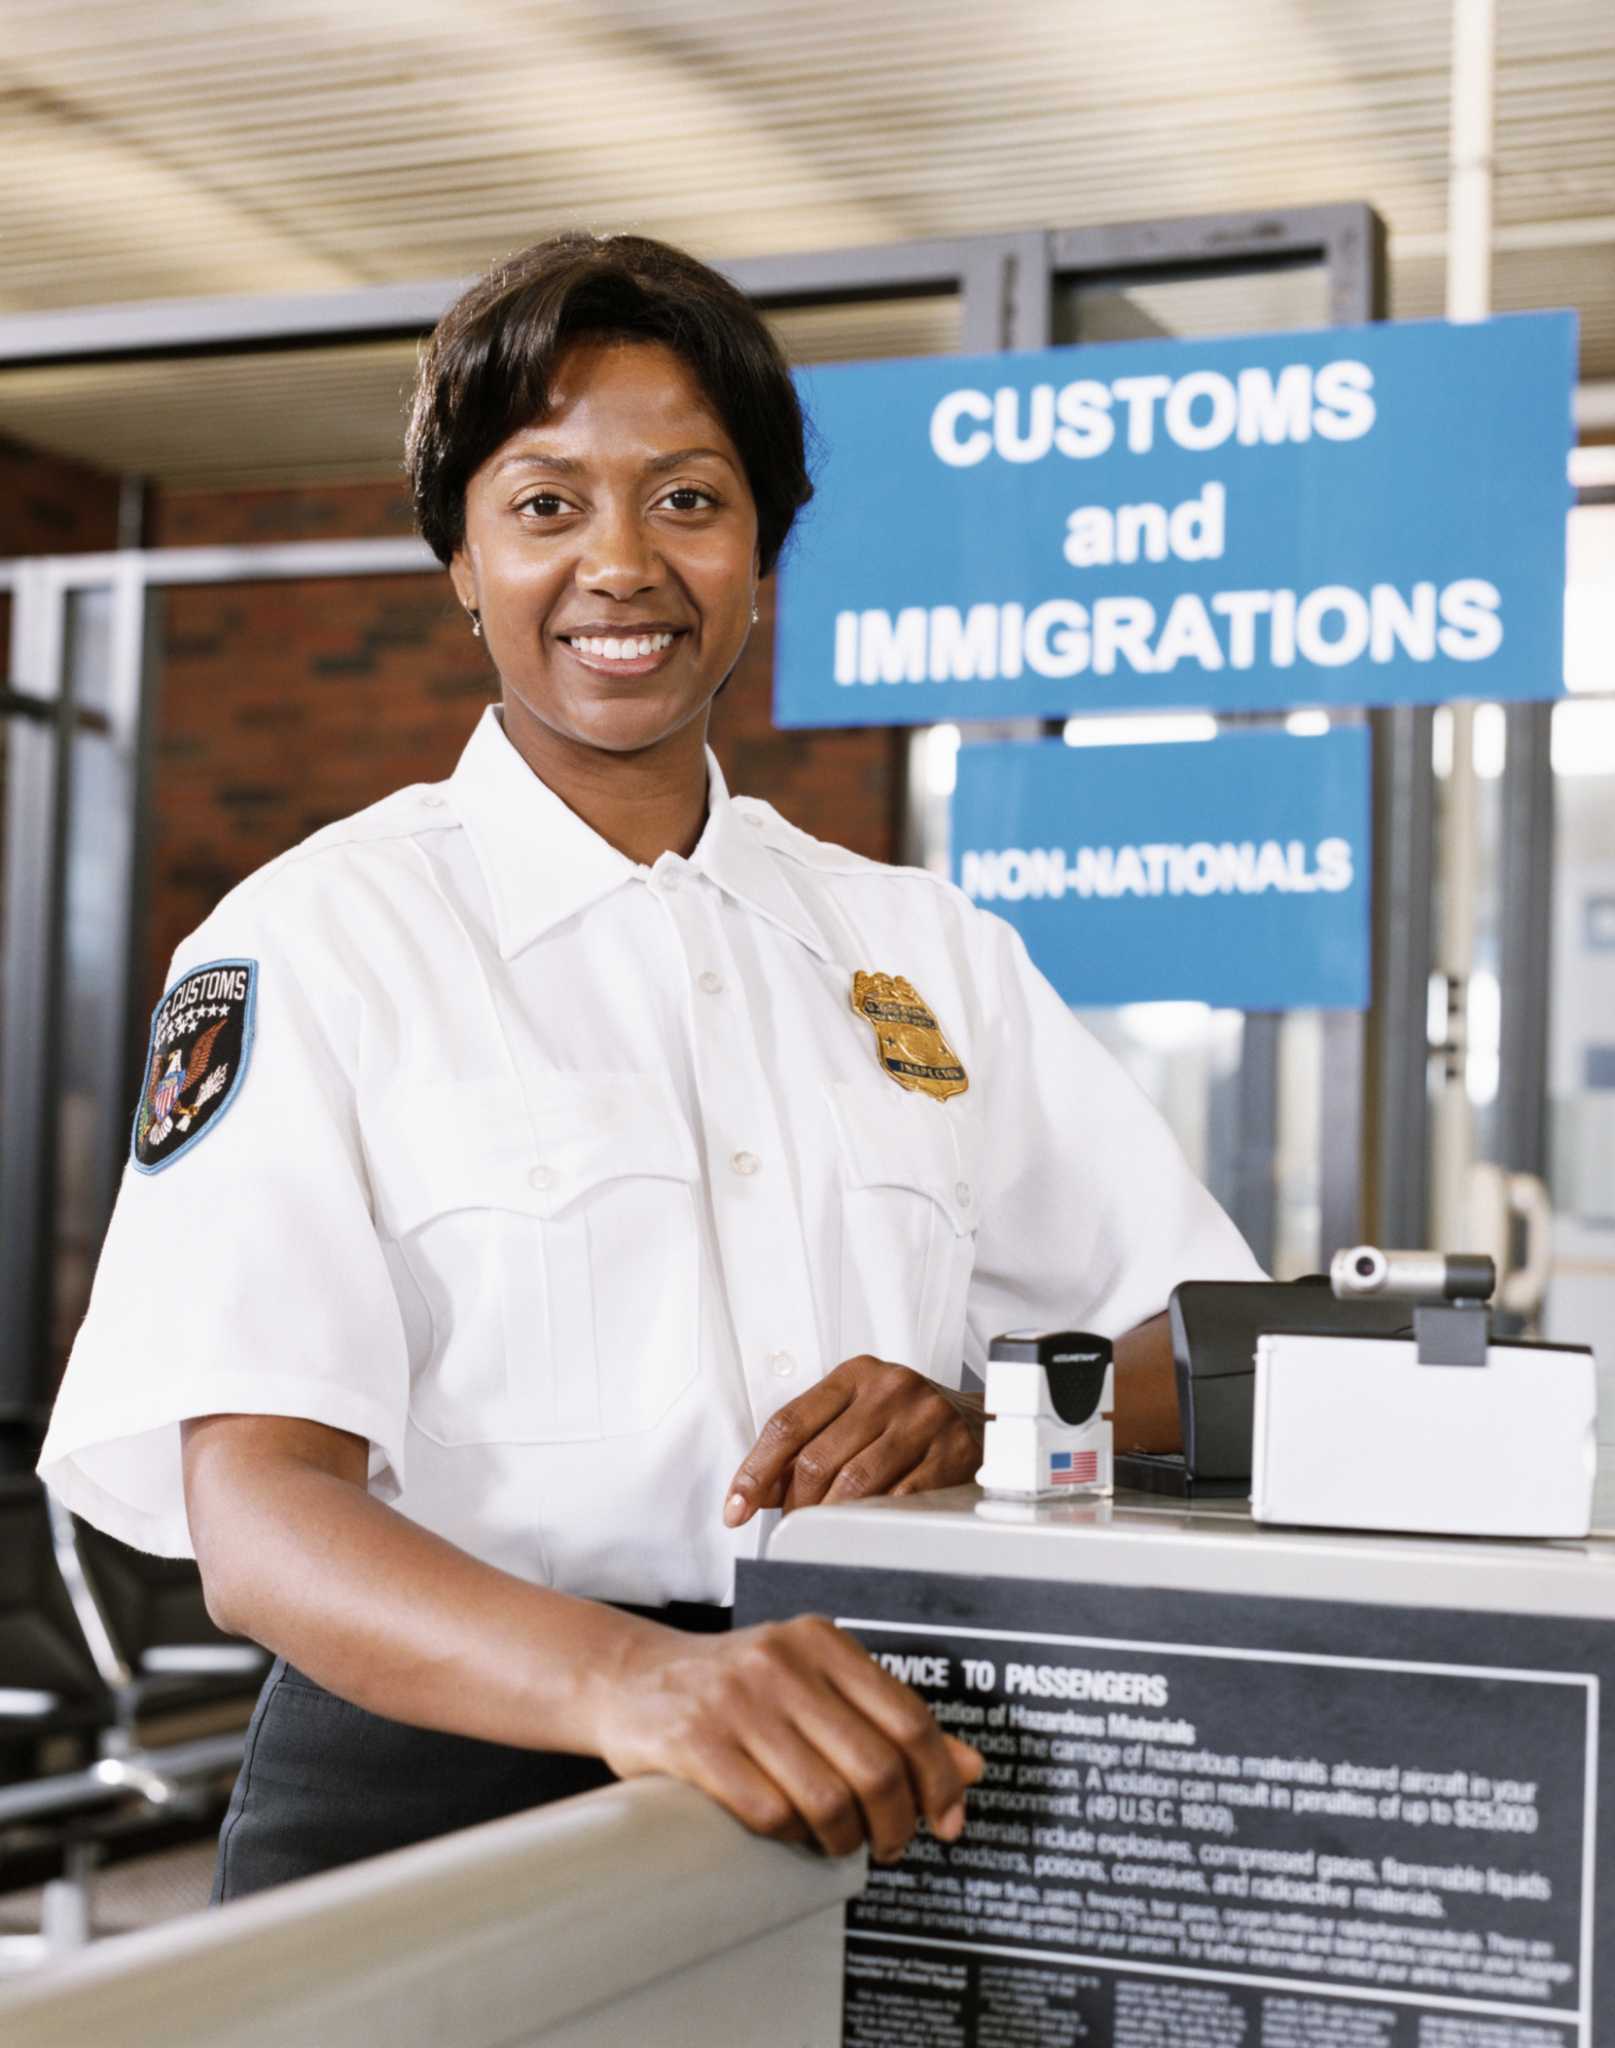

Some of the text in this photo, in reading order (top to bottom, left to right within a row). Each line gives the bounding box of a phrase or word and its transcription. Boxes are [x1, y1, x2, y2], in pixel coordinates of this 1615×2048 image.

[930, 361, 1377, 468] CUSTOMS
[1063, 481, 1227, 568] and
[834, 578, 1504, 687] IMMIGRATIONS
[962, 837, 1355, 902] NON-NATIONALS
[171, 970, 248, 1017] CUSTOMS
[961, 1660, 996, 1692] TO
[1005, 1663, 1168, 1707] PASSENGERS
[1010, 1704, 1105, 1737] Hazardous
[1108, 1712, 1196, 1745] Materials
[1020, 1735, 1048, 1759] the
[1123, 1742, 1144, 1767] of
[1145, 1744, 1240, 1776] hazardous
[1085, 1766, 1101, 1790] A
